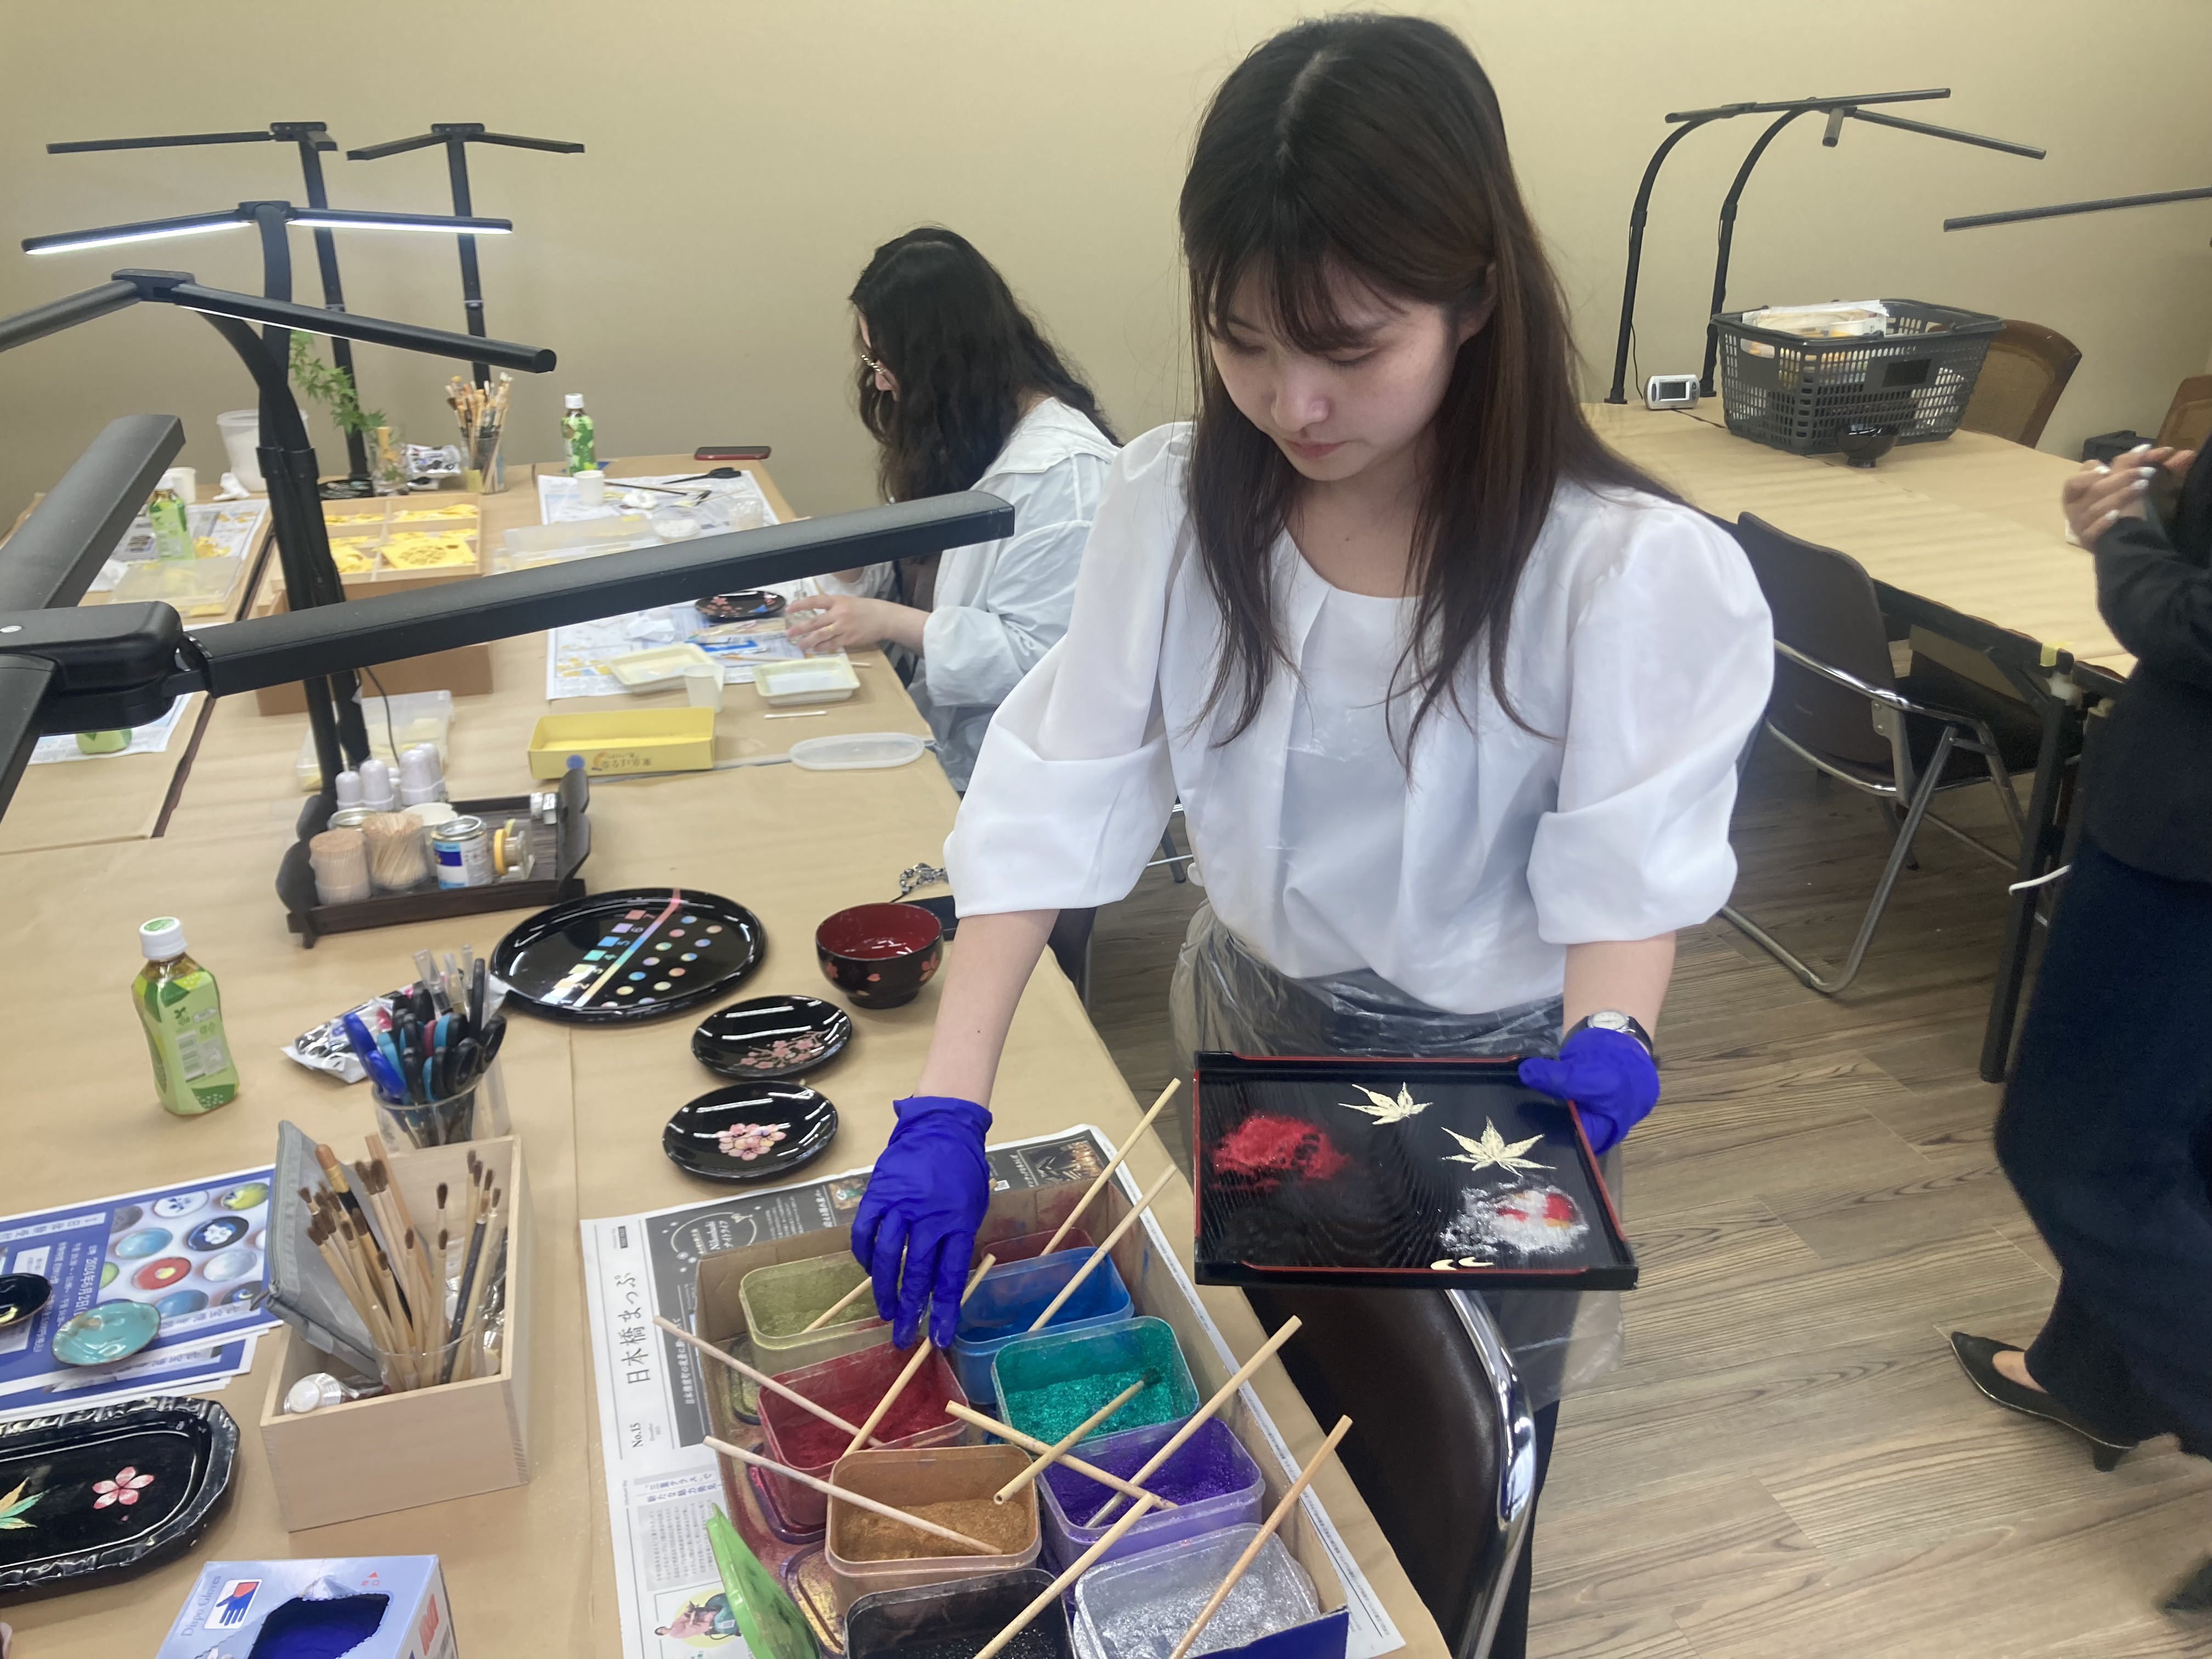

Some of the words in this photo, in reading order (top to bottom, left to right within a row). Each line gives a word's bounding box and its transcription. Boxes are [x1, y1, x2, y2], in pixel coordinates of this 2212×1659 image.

[614, 1272, 651, 1384] 日本橋まっぷ
[630, 1423, 644, 1448] No.15
[180, 1609, 204, 1637] Dispo
[198, 1576, 222, 1606] Gloves
